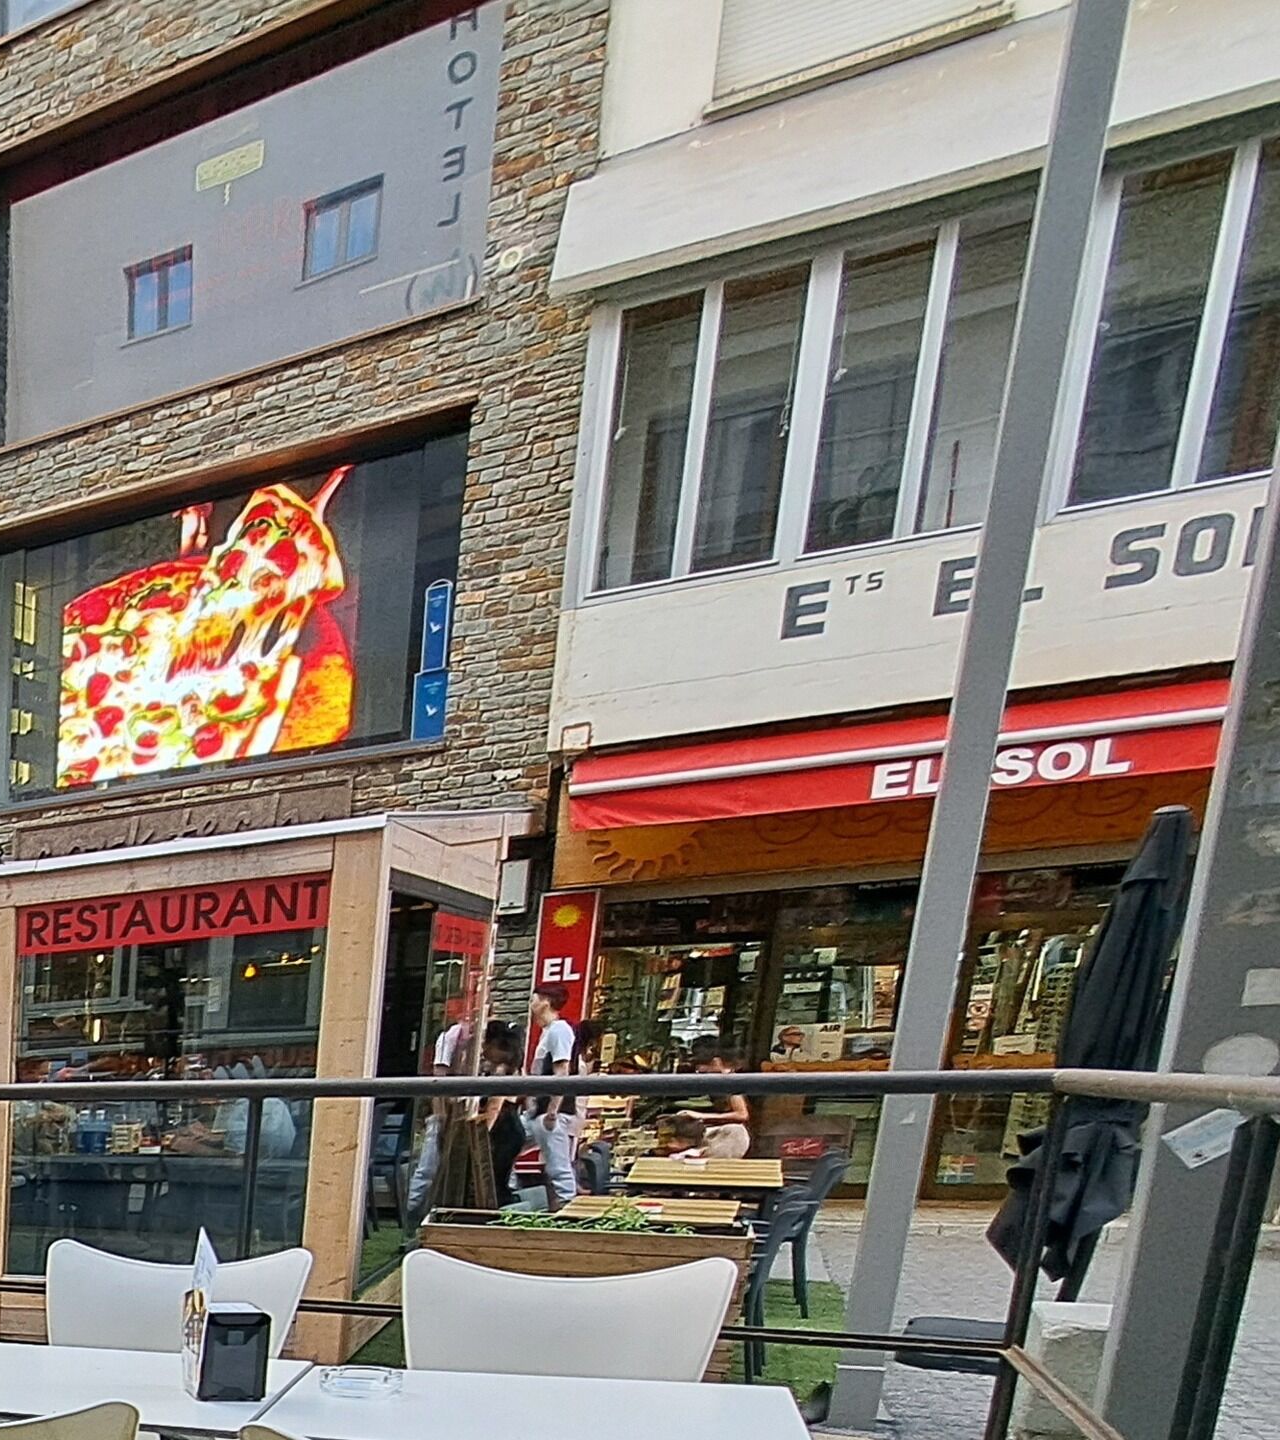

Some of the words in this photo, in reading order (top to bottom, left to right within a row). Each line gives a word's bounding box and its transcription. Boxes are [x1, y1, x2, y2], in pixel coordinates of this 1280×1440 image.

[933, 556, 1044, 617] E
[870, 758, 943, 800] EL
[990, 738, 1132, 787] SOL
[26, 877, 327, 948] RESTAURANT
[542, 956, 581, 983] EL
[819, 1024, 841, 1033] AIR
